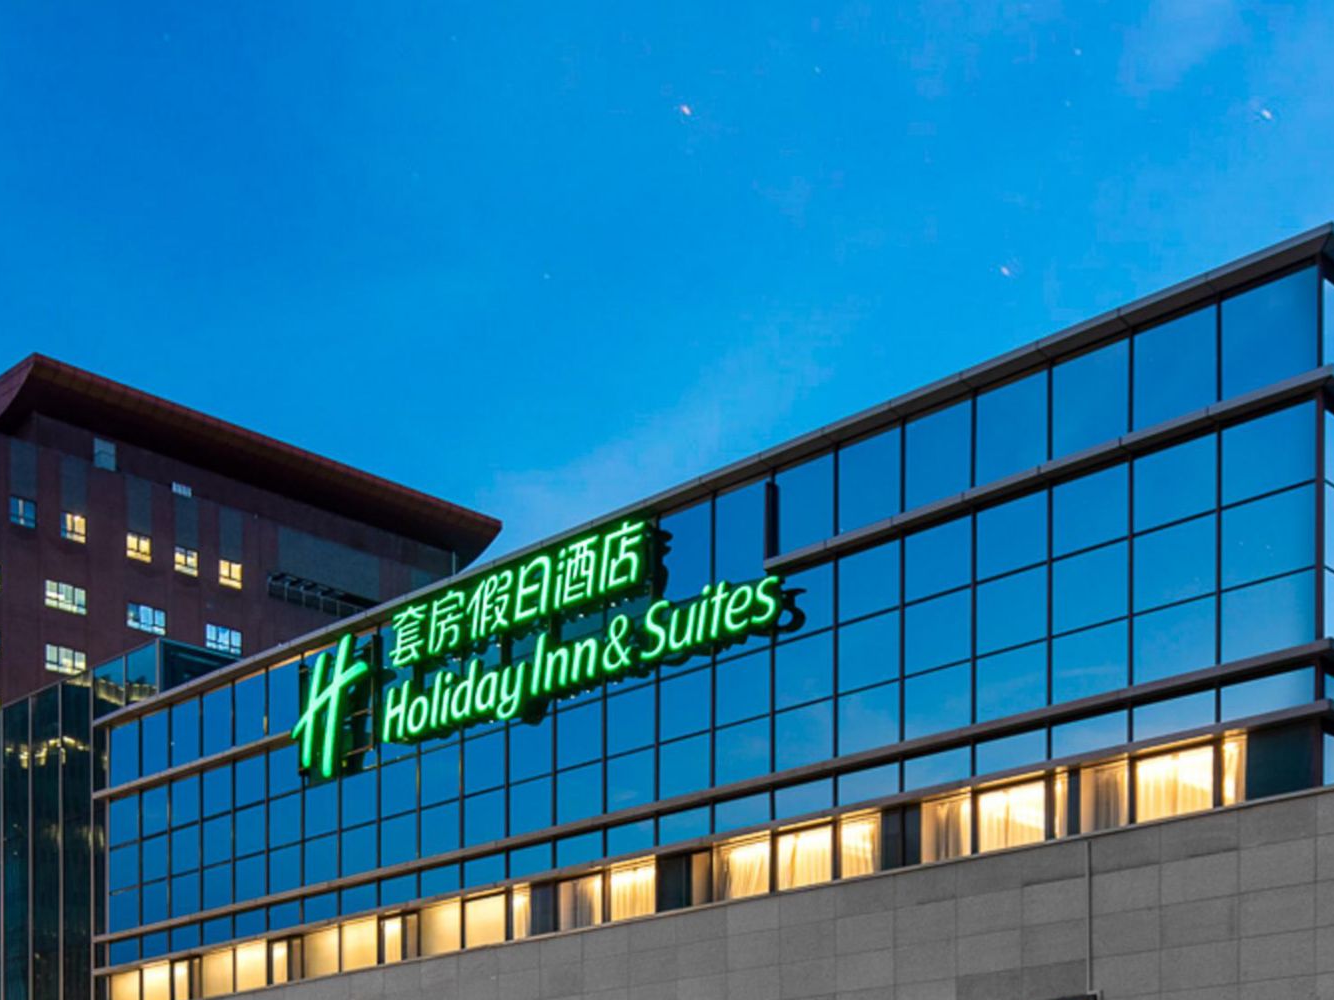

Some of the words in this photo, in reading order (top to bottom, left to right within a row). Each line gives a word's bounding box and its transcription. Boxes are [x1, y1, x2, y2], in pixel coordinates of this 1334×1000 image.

[382, 654, 525, 743] Holiday
[530, 633, 597, 694] Inn
[602, 614, 631, 672] &
[639, 576, 780, 661] Suites
[389, 520, 644, 667] 套房假日酒店
